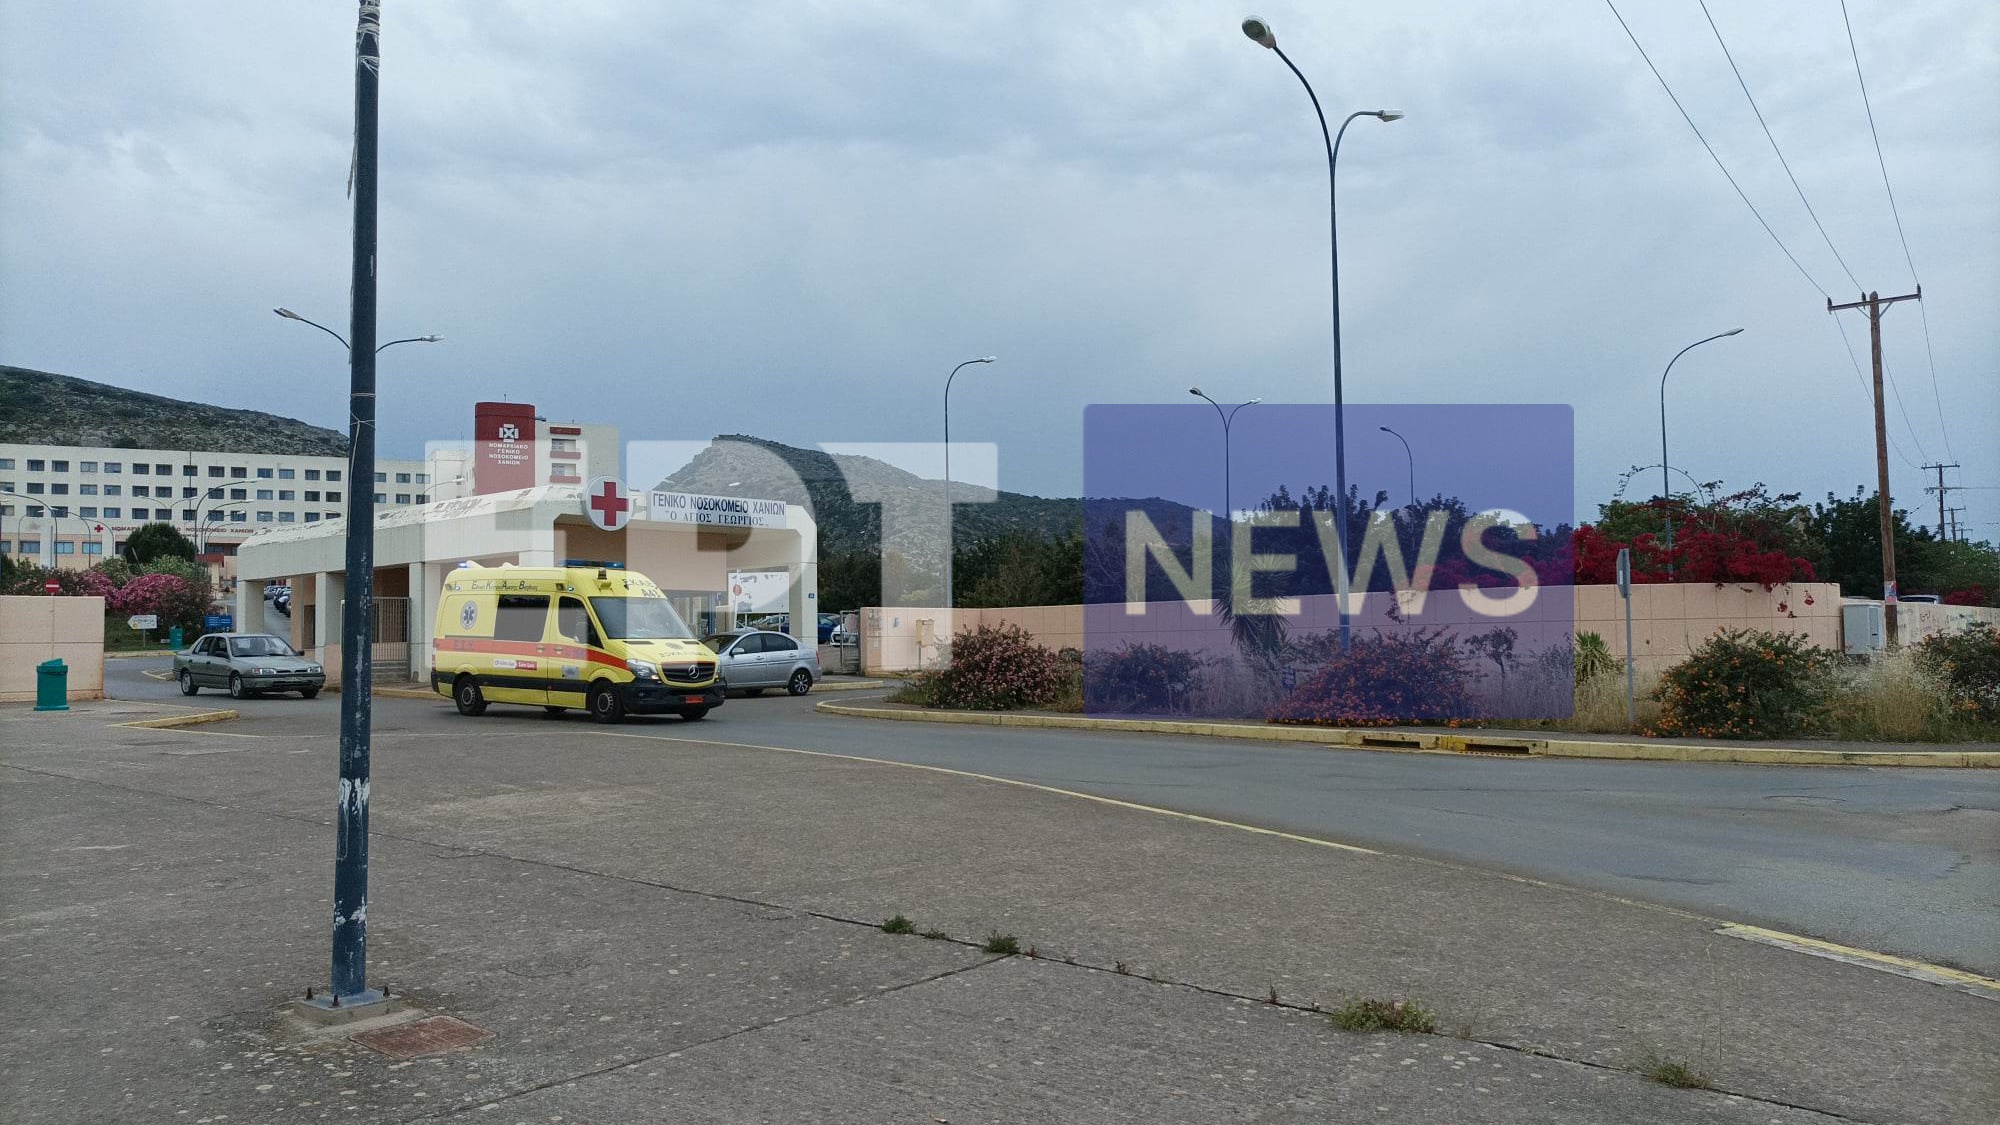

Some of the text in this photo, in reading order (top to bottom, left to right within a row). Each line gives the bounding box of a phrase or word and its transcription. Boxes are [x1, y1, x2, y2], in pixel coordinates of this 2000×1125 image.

[653, 493, 785, 516] ΓΕΝΙΚΟ ΝΟΣΟΚΟΜΕΙΟ ΧΑΝΙΩΝ
[684, 513, 712, 523] ΑΓΙΟΣ
